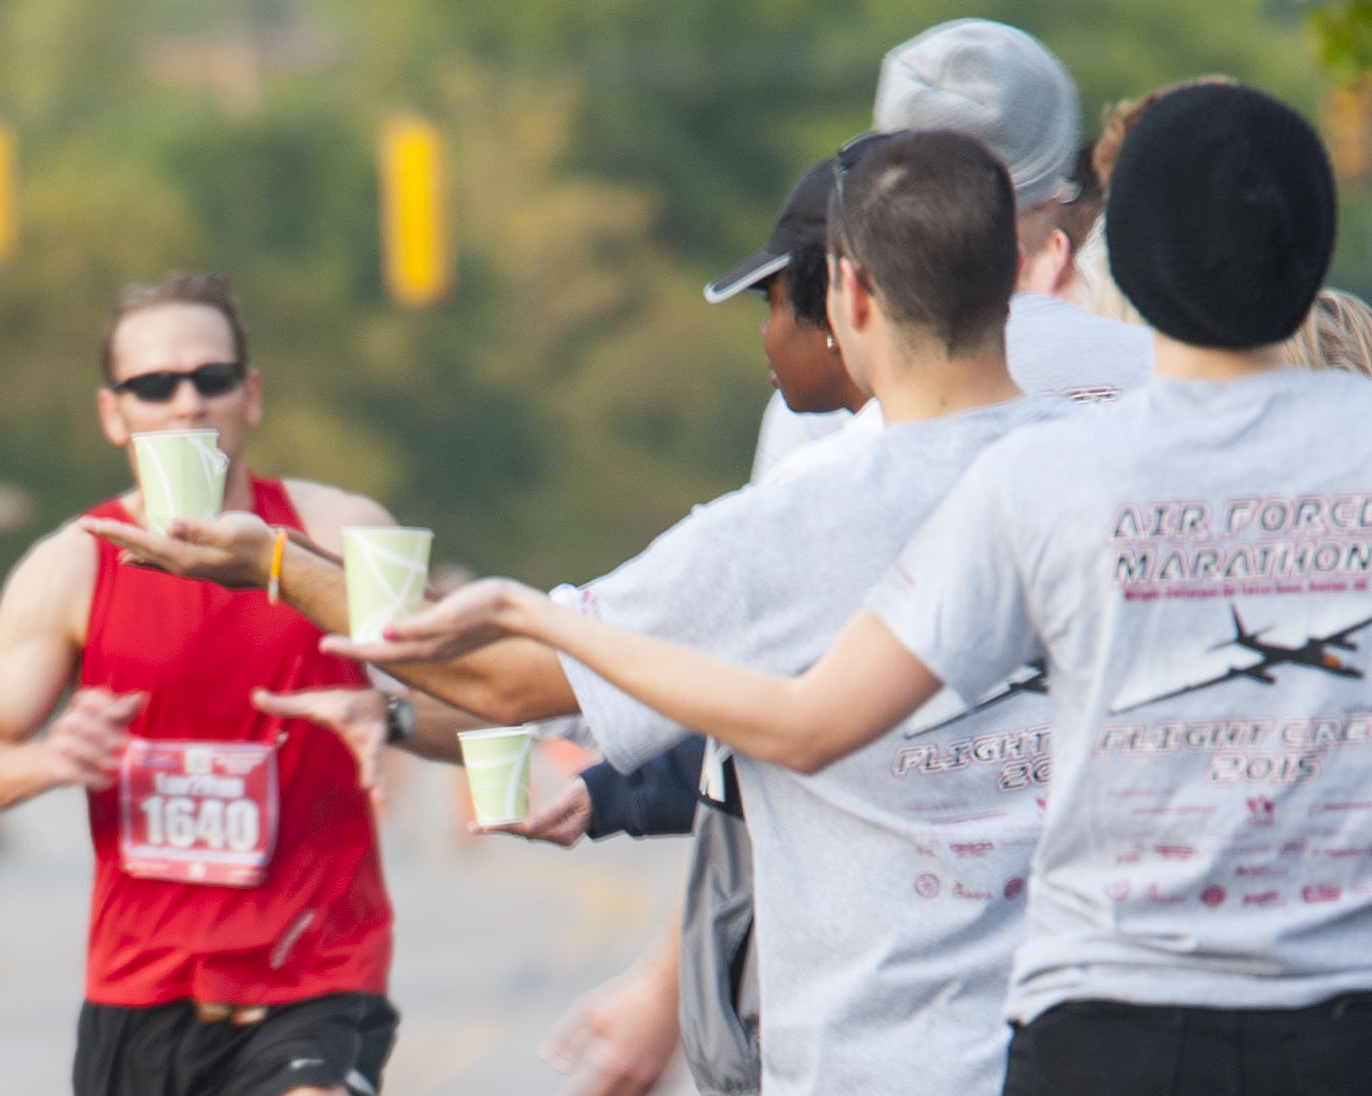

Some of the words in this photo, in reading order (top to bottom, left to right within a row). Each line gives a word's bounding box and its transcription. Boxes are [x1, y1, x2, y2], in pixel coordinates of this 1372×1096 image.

[1106, 499, 1213, 542] AIR
[1108, 541, 1372, 583] MARATHON
[892, 726, 1052, 776] FLIGHT
[1093, 722, 1272, 757] FLIGHT
[1207, 752, 1321, 784] 2015
[140, 795, 260, 852] 1640
